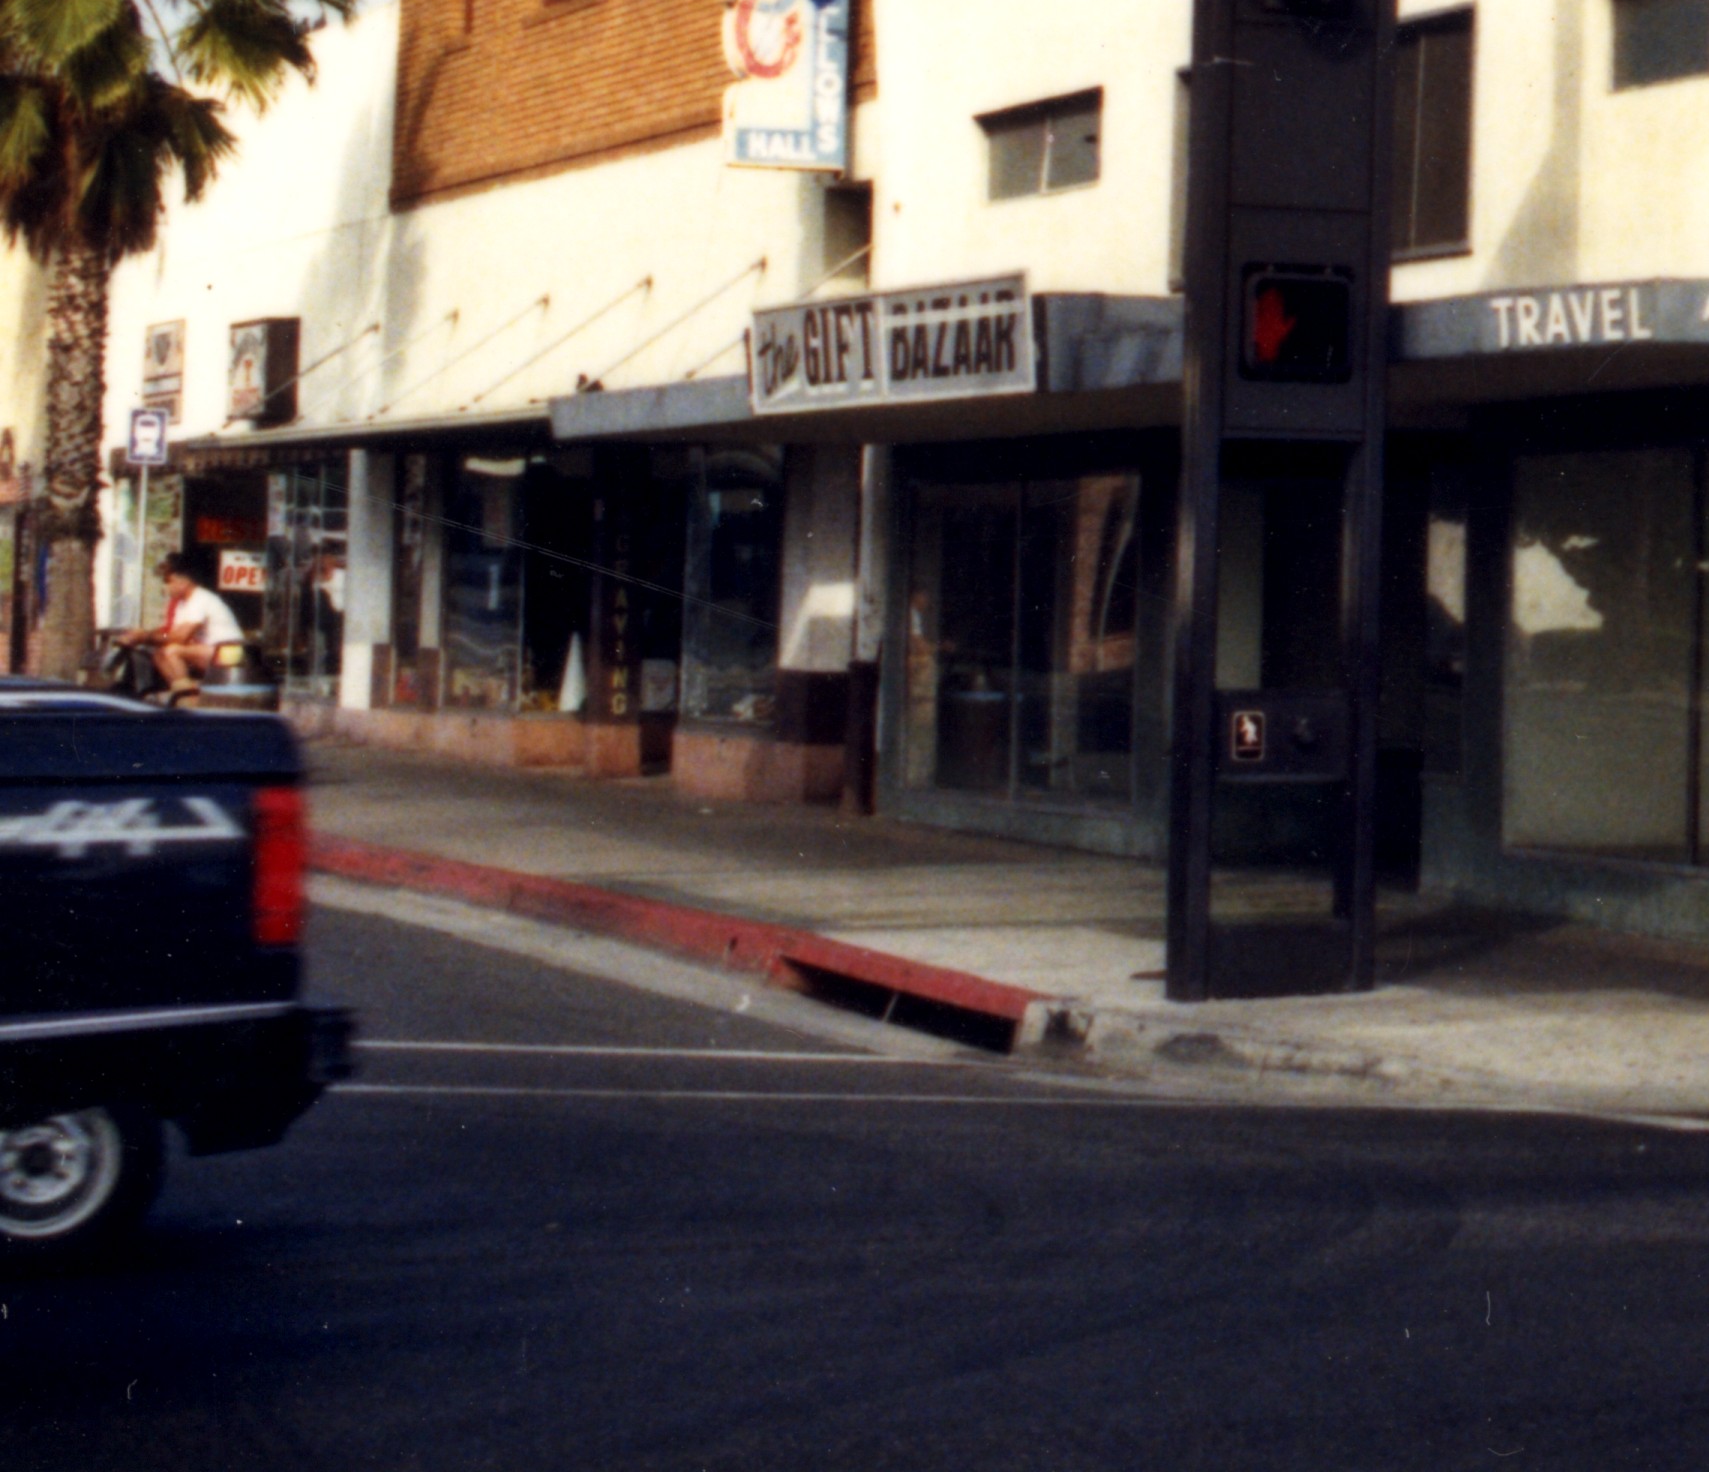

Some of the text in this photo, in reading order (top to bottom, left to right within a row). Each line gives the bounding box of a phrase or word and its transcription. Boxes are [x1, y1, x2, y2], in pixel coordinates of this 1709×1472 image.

[746, 130, 817, 161] HALL
[803, 300, 874, 387] GIFT
[890, 290, 1016, 381] BAZAAR
[1490, 288, 1653, 348] TRAVEL
